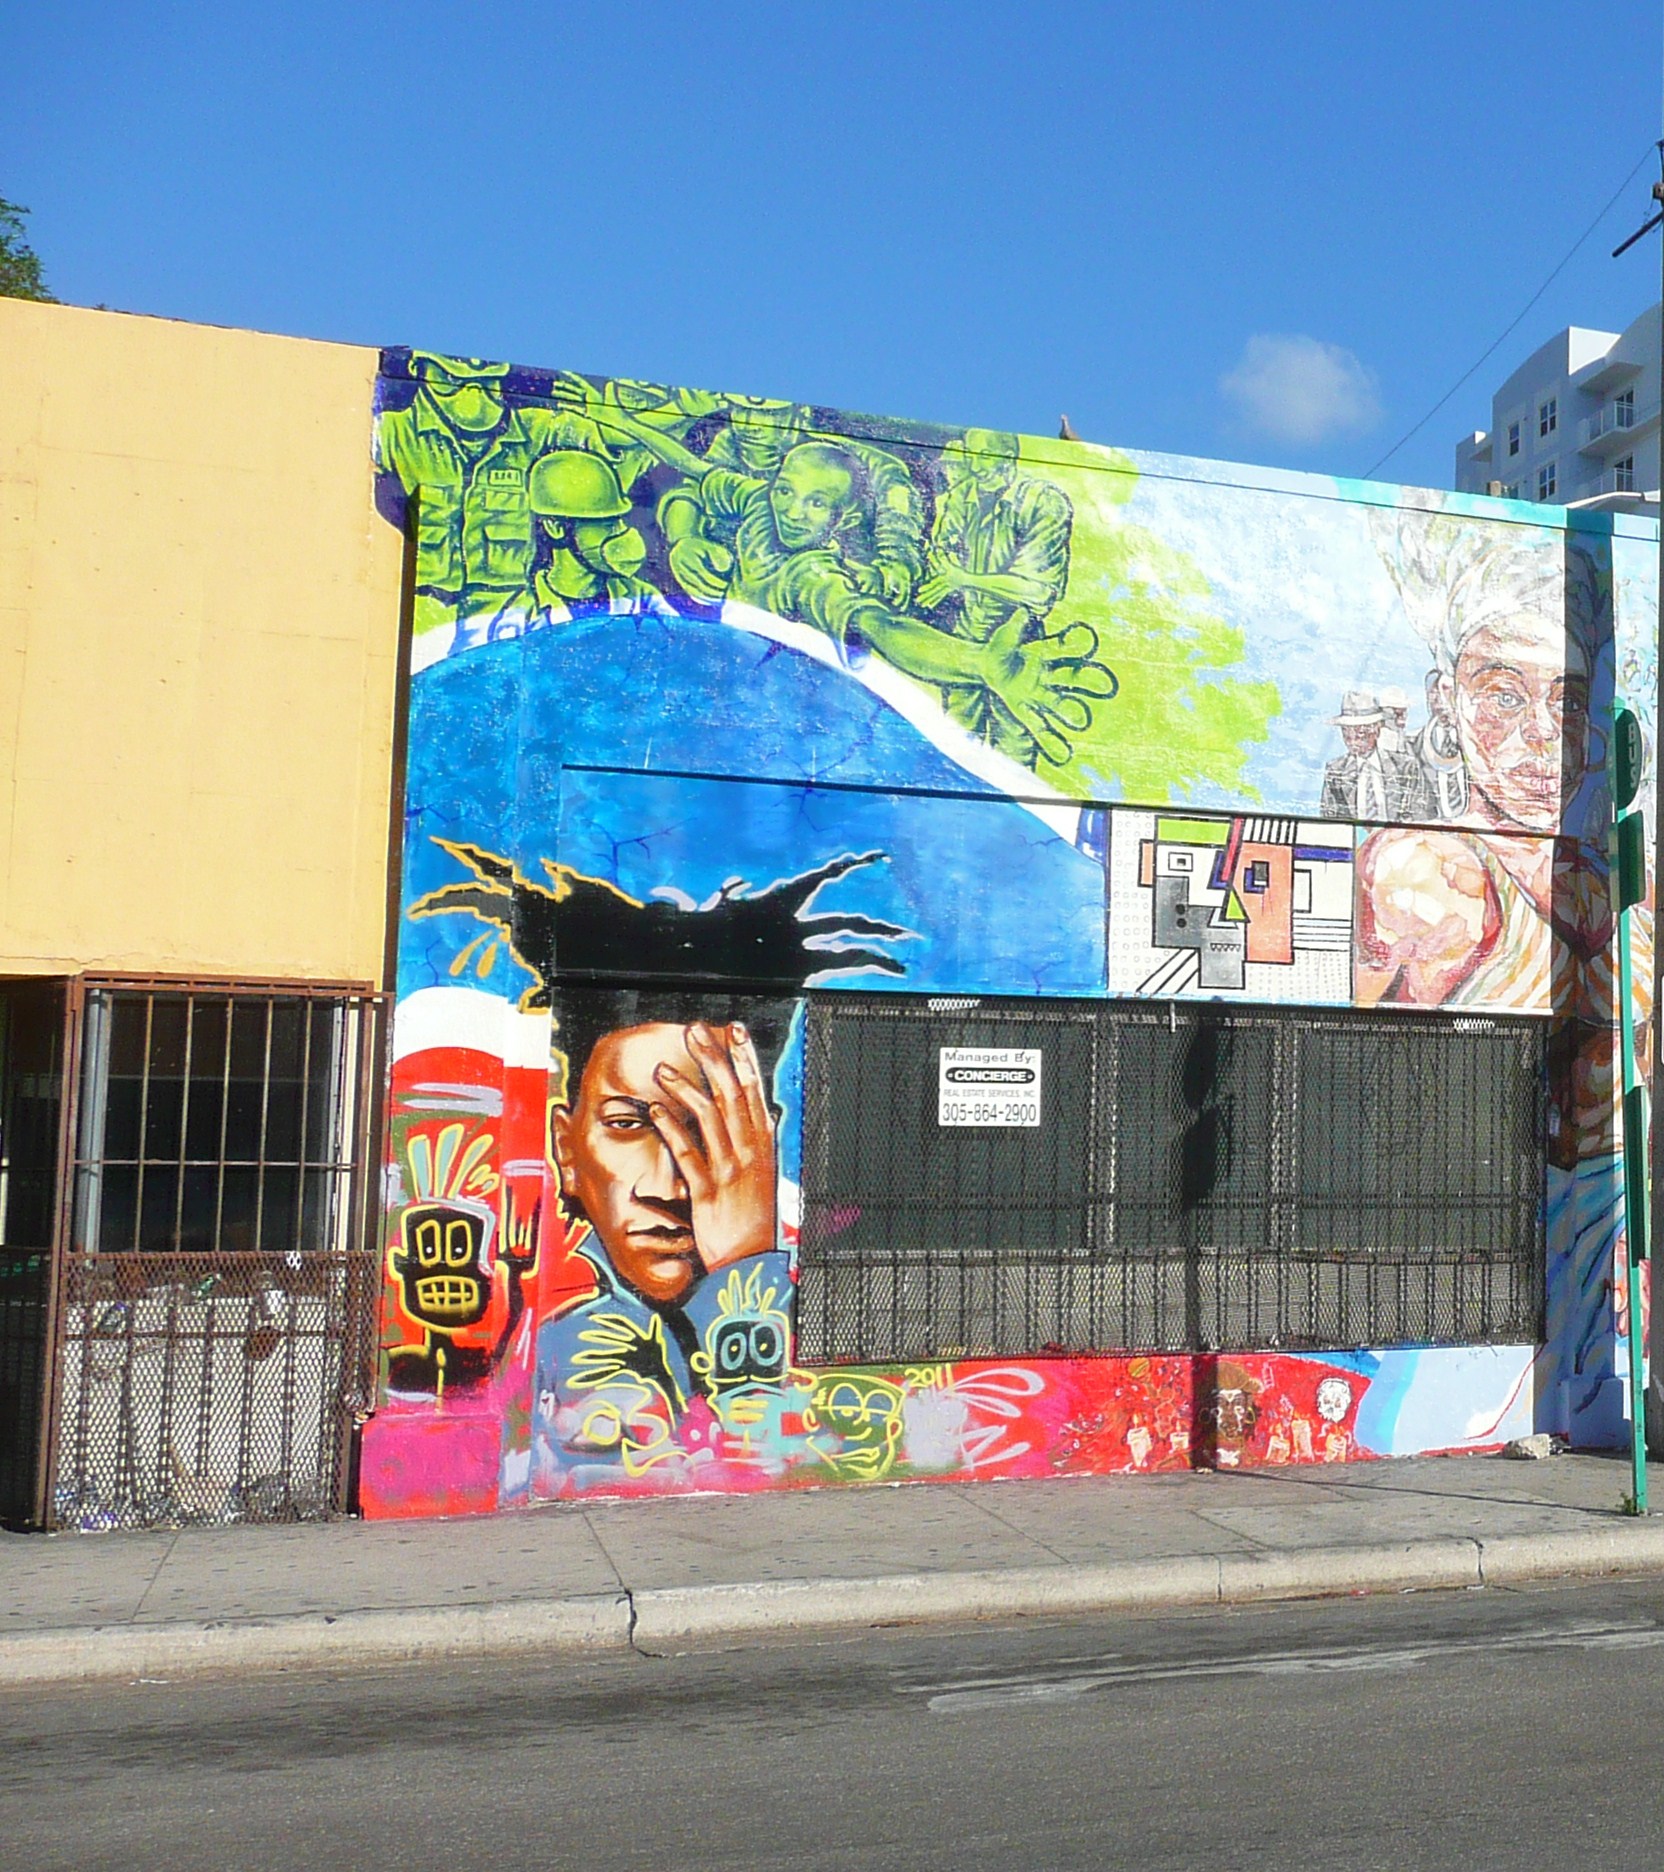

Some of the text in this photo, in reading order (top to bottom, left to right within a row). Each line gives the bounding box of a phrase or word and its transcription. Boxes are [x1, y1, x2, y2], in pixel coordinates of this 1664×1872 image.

[1627, 722, 1637, 789] BUS
[944, 1052, 1008, 1064] Managed
[954, 1070, 1027, 1082] CONCIERGE
[943, 1089, 960, 1097] REAL
[962, 1089, 985, 1098] ESTATE
[943, 1103, 1037, 1123] 305-864-2900
[904, 1363, 955, 1390] 2011
